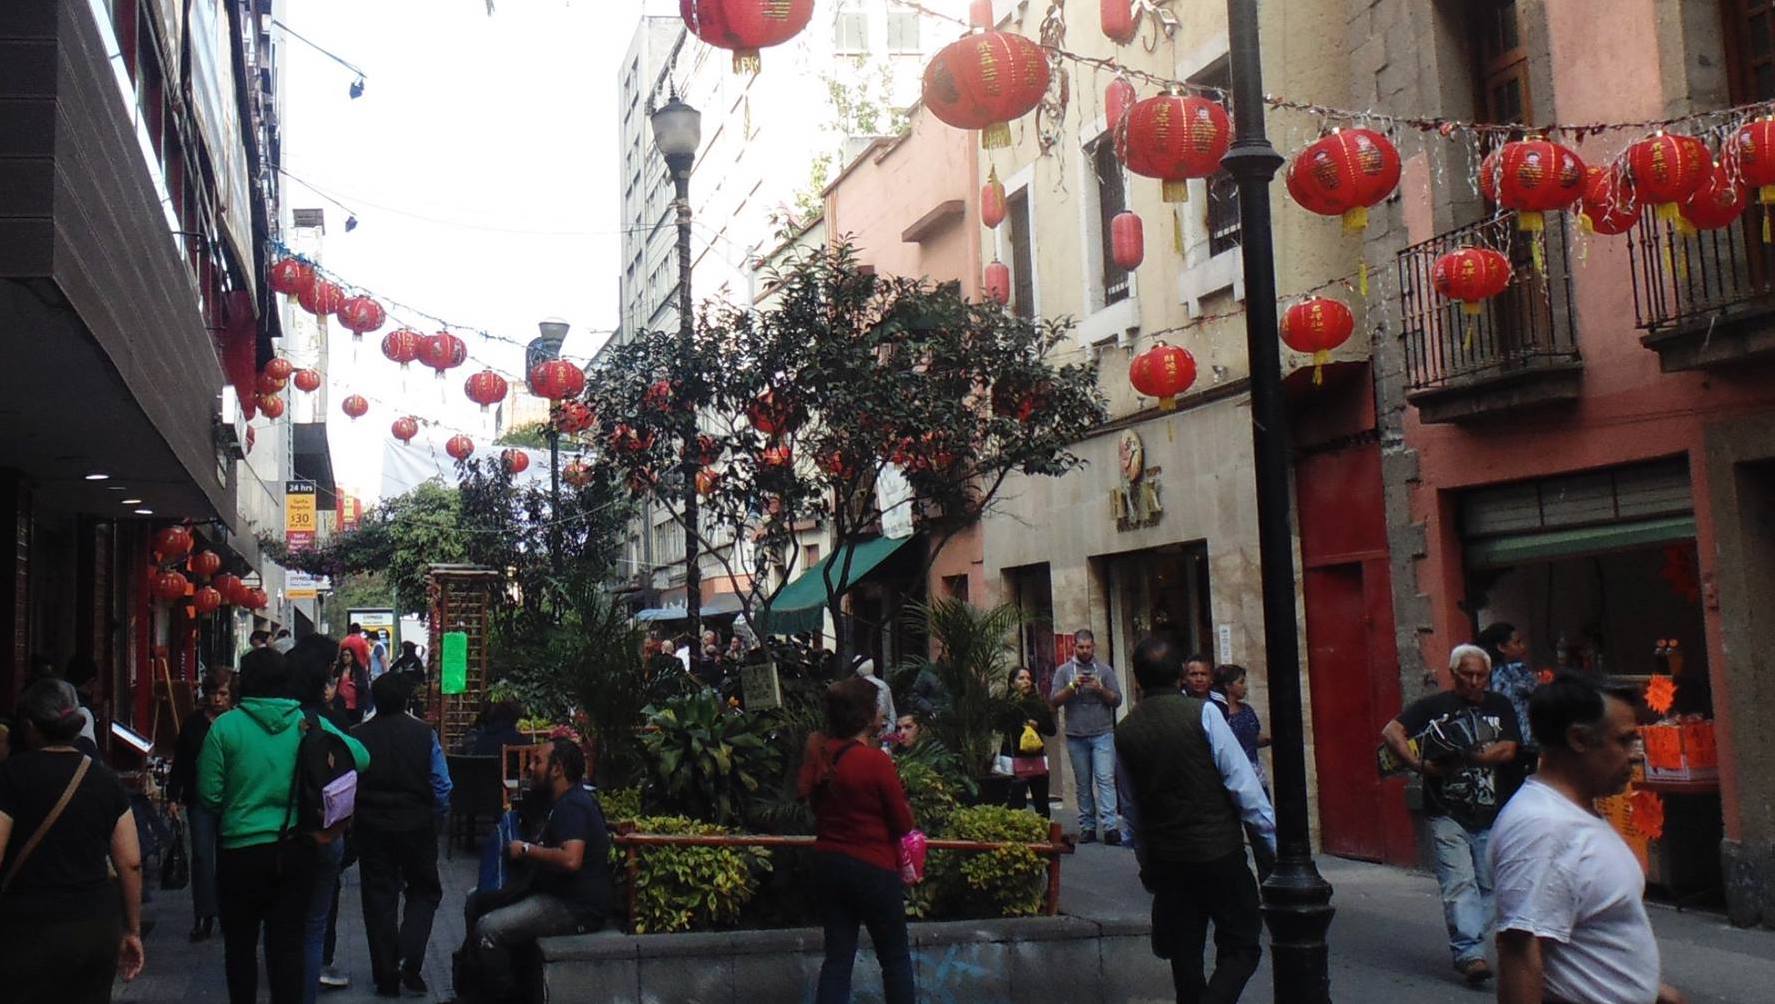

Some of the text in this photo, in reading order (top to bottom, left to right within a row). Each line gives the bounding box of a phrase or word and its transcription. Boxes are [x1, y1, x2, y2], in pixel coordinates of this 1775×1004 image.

[289, 483, 313, 492] 24 hrs
[291, 513, 309, 523] $30
